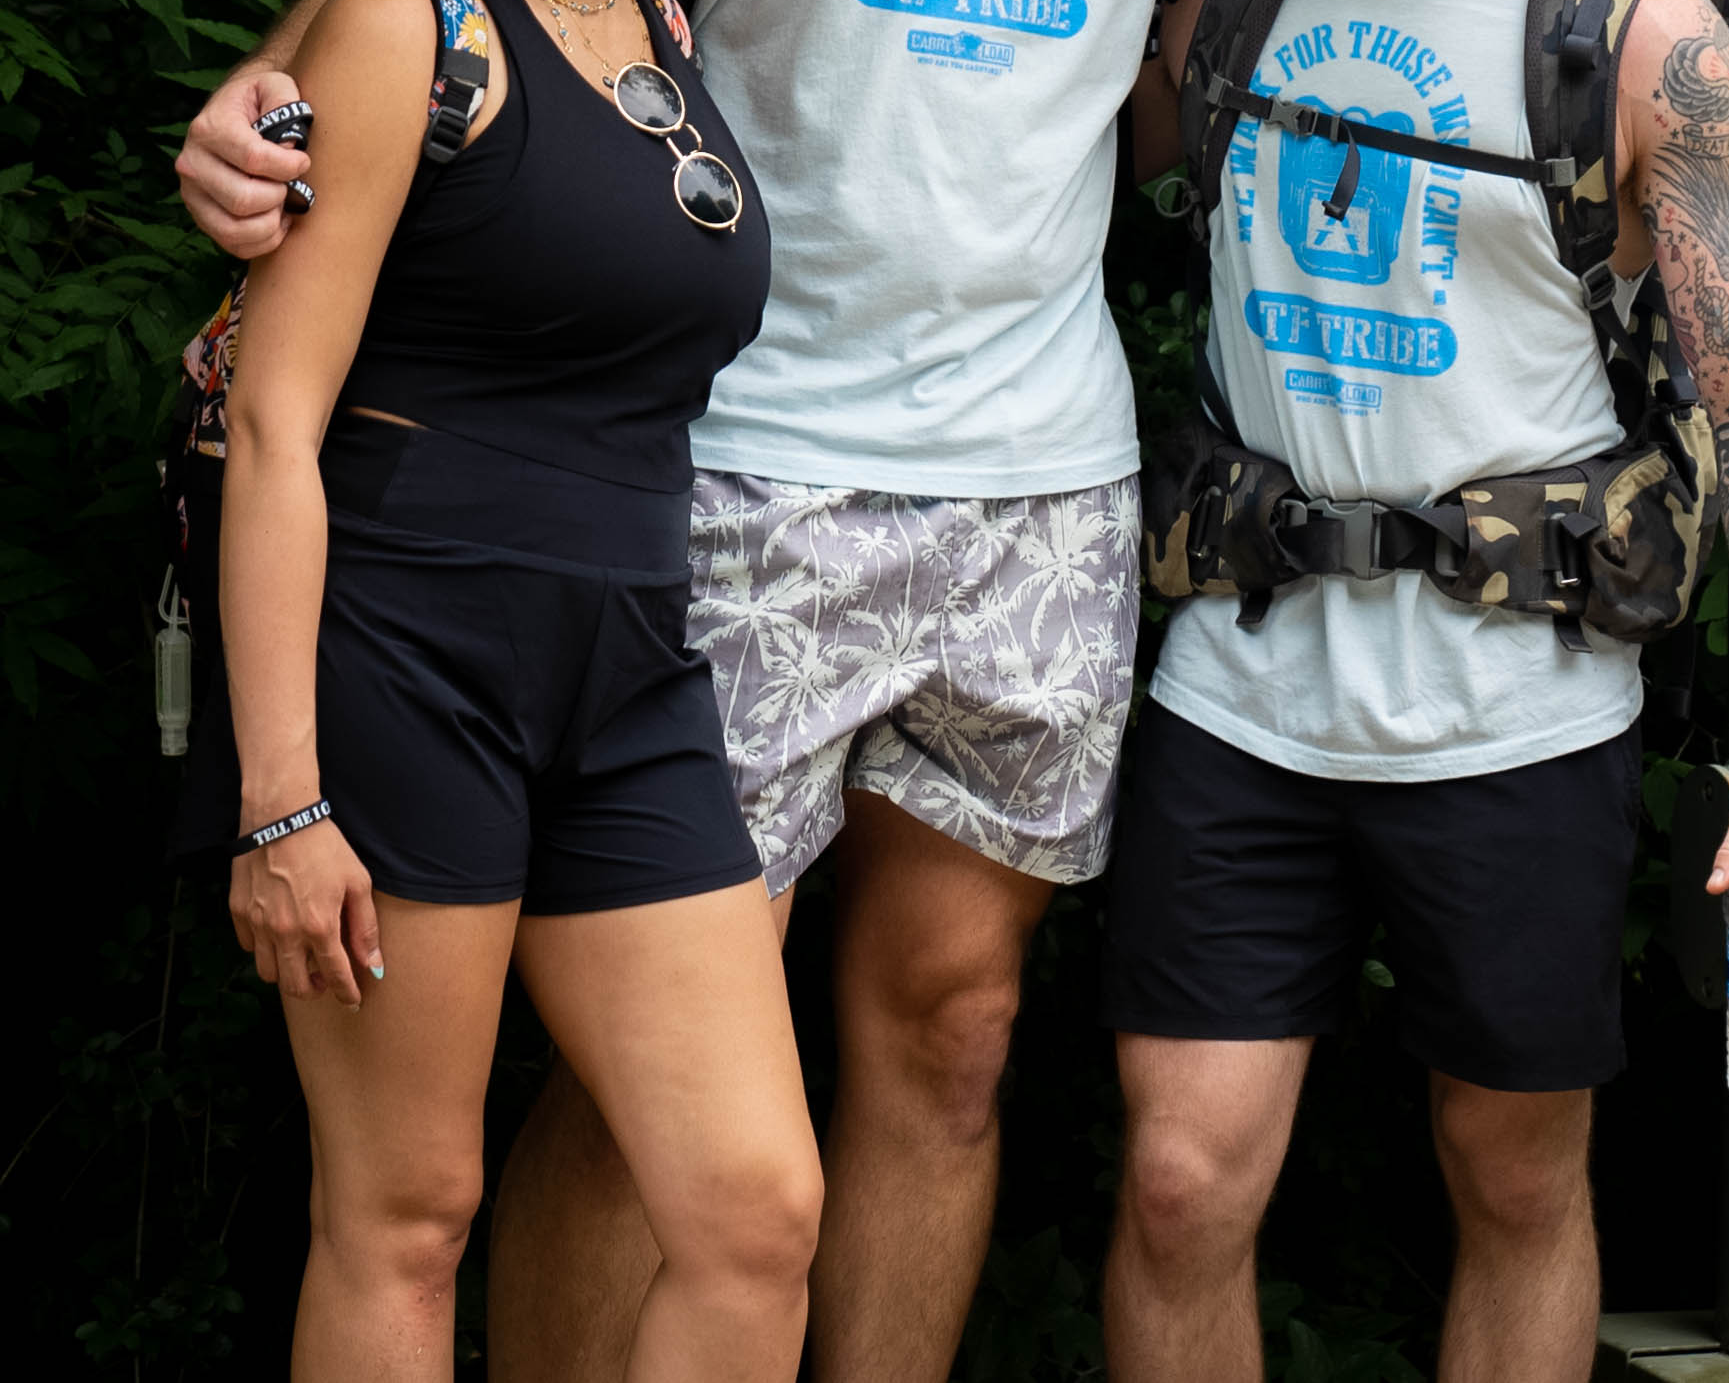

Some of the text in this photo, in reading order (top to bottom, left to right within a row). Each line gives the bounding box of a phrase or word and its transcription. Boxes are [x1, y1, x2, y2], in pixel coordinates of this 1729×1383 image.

[1274, 20, 1462, 281] FOR THOSE CAN'T
[1316, 311, 1442, 368] TRIBE
[253, 819, 291, 847] TELL
[291, 807, 314, 831] ME
